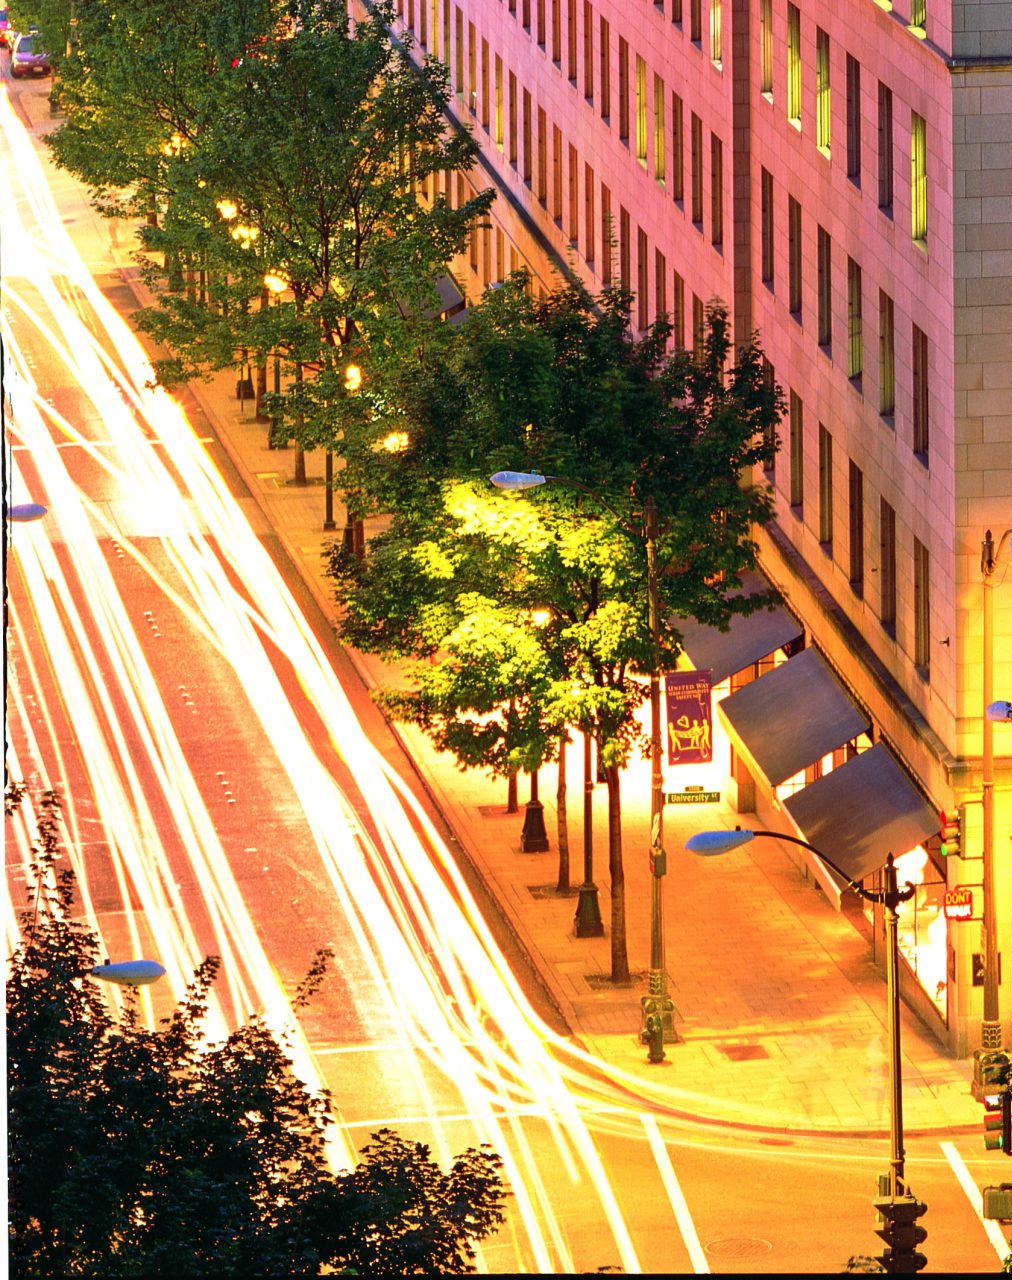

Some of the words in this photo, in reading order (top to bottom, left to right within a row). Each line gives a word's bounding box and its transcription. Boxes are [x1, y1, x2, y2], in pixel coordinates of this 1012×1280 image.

[668, 684, 695, 692] UNITED
[671, 793, 710, 802] University
[945, 892, 971, 904] DONT
[945, 904, 971, 917] WALK
